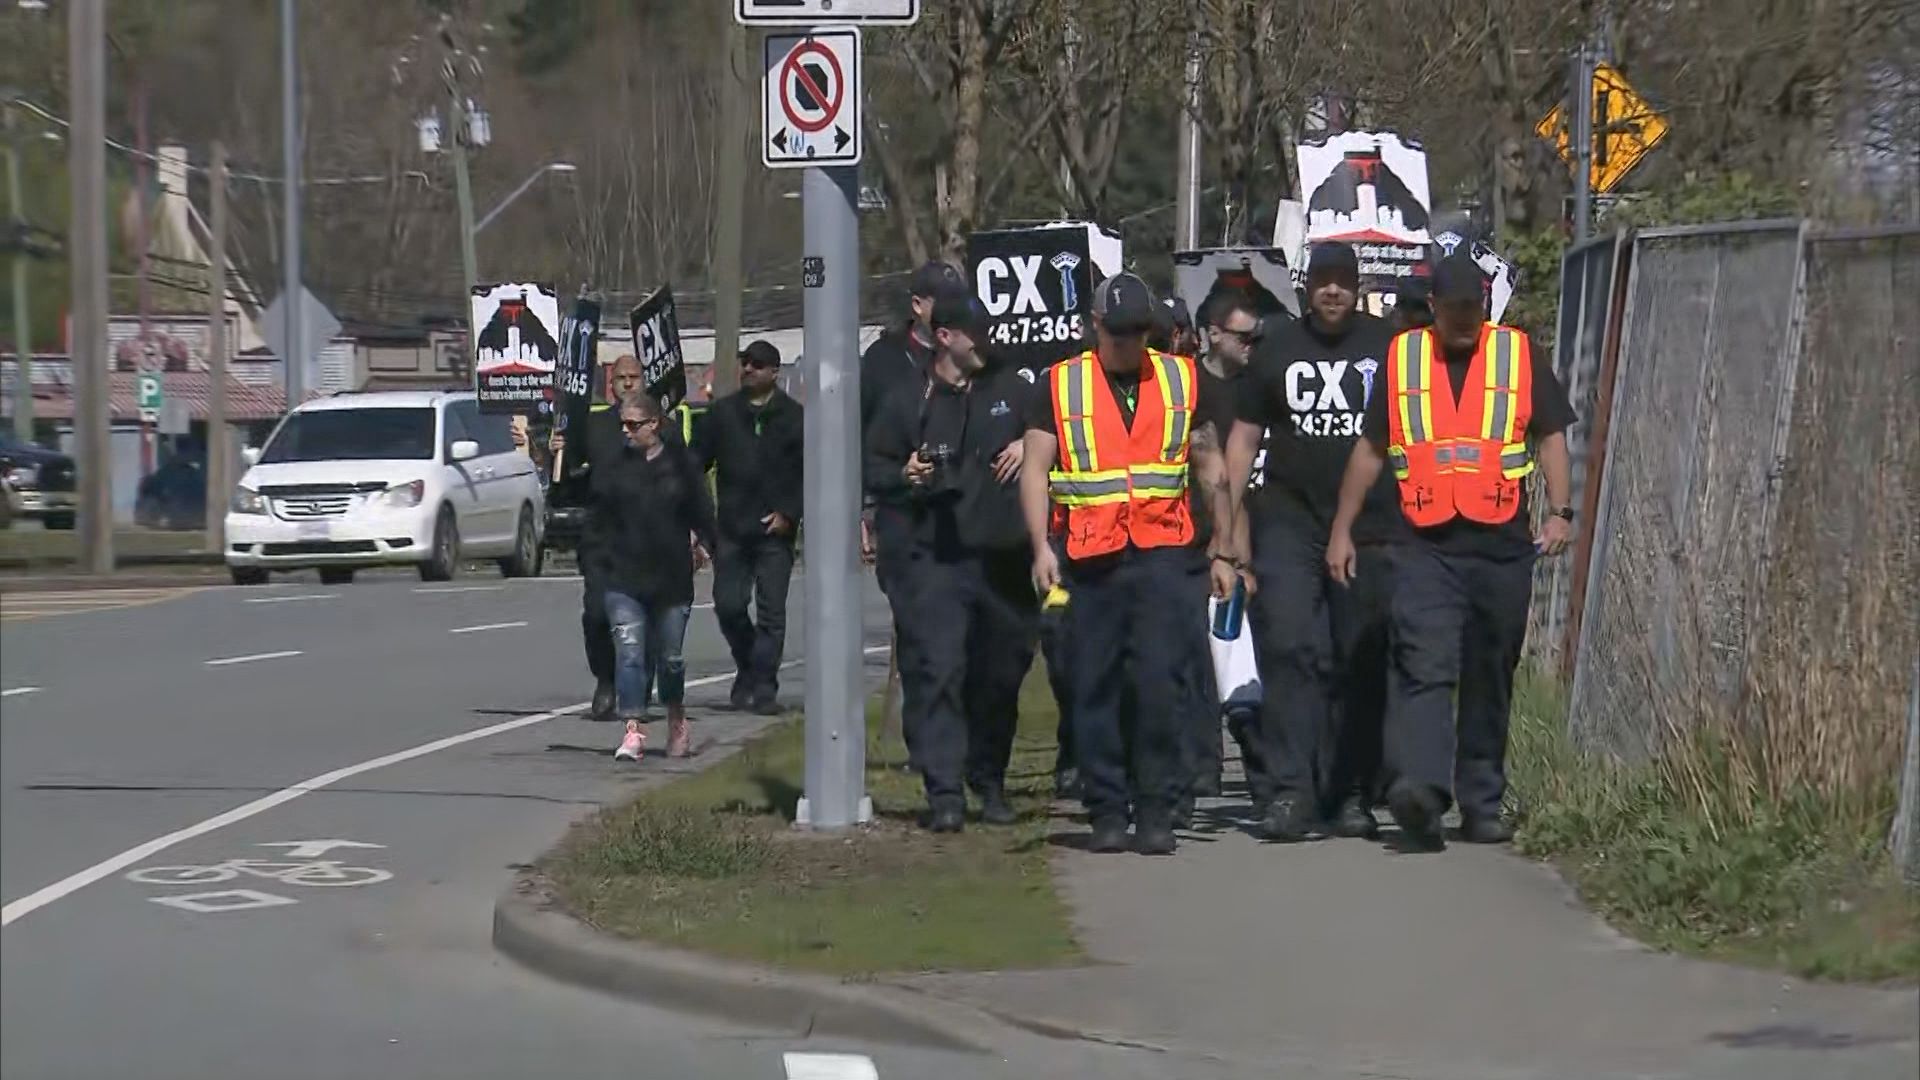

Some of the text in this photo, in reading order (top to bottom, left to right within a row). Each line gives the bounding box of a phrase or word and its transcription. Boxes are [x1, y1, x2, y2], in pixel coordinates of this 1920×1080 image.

[976, 255, 1048, 316] CX
[637, 312, 667, 368] CX
[141, 379, 160, 406] P
[1285, 361, 1350, 412] CX
